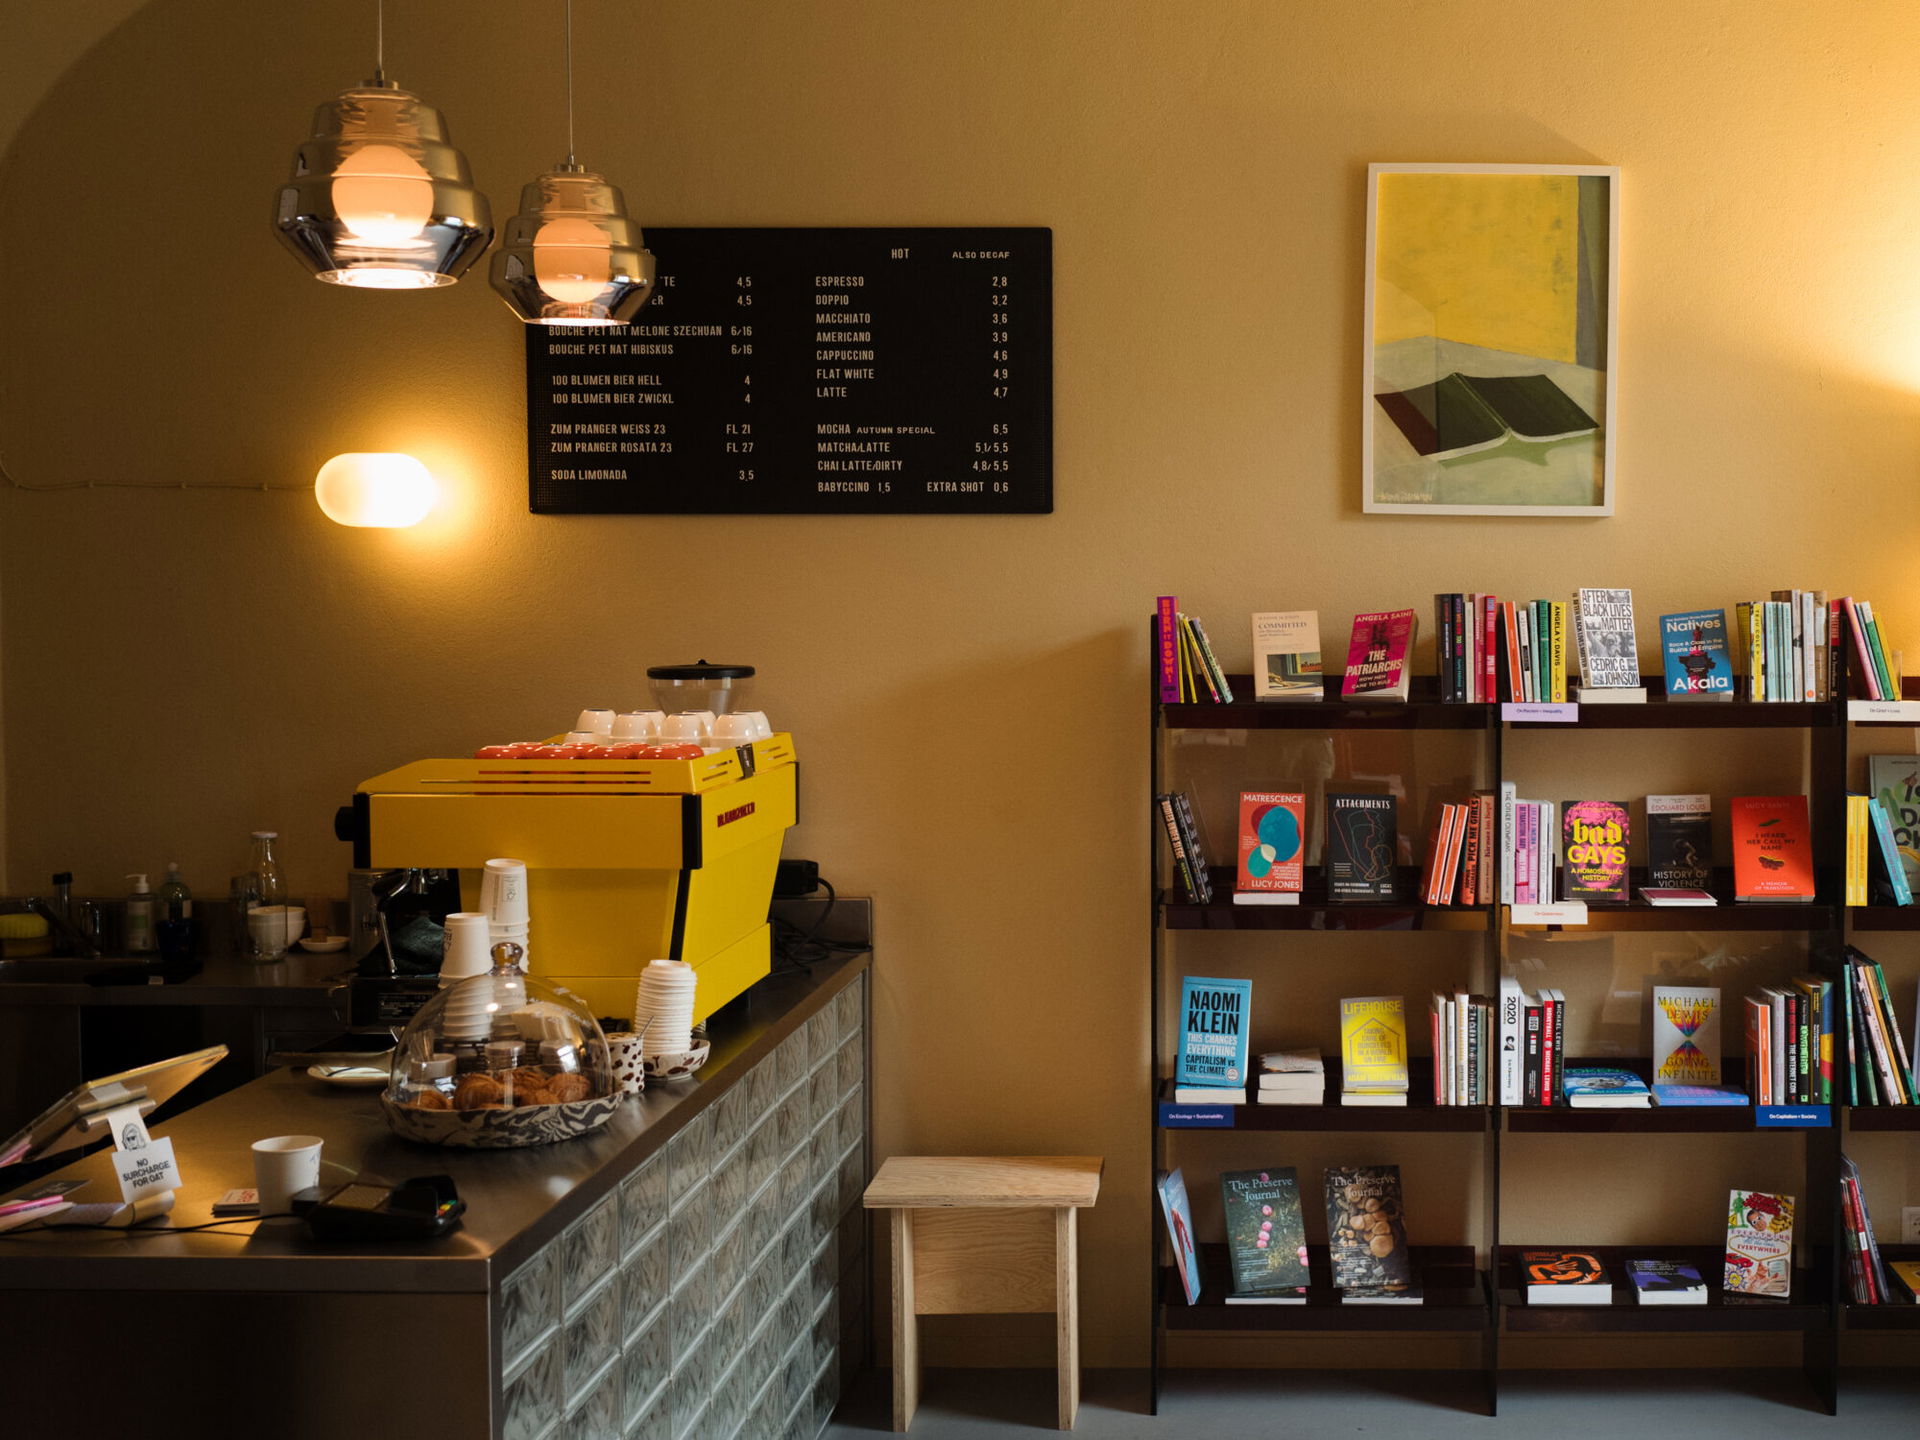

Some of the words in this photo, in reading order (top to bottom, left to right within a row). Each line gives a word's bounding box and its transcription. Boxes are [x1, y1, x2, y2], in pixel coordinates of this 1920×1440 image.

[891, 248, 909, 259] HOT
[952, 251, 977, 259] ALSO
[979, 251, 1010, 259] DECAF
[815, 276, 865, 287] ESPRESSO
[815, 295, 849, 306] DOPPIO
[815, 313, 871, 324] MACCHIATO
[548, 326, 585, 337] BOUCHE
[588, 326, 607, 337] PET
[609, 326, 627, 337] NAT
[630, 326, 670, 336] MELONE
[673, 325, 722, 336] SZECHUAN
[730, 325, 753, 337] 6/16
[816, 331, 871, 343] AMERICANO
[549, 344, 586, 355] BOUCHE
[588, 344, 607, 355] PET
[609, 344, 628, 355] NAT
[630, 344, 674, 355] HIBISKUS
[731, 344, 753, 355] 6/16
[816, 349, 874, 361] CAPPUCCINO
[816, 368, 841, 379] FLAT
[843, 368, 875, 379] WHITE
[552, 375, 568, 386] 100
[570, 375, 611, 386] BLUMEN
[613, 375, 635, 386] BIER
[637, 375, 662, 386] HELL
[744, 375, 751, 386] 4
[816, 386, 847, 398] LATTE
[552, 393, 568, 404] 100
[571, 393, 611, 404] BLUMEN
[613, 393, 635, 404] BIER
[637, 393, 674, 404] ZWICKL
[744, 393, 751, 404] 4
[550, 424, 572, 435] ZUM
[574, 424, 617, 435] PRANGER
[620, 424, 651, 435] WEISS
[653, 424, 666, 435] 23
[726, 424, 739, 435] FL
[817, 423, 851, 435] MOCHA
[856, 426, 893, 435] AUTUMN
[896, 426, 936, 435] SPECIAL
[550, 442, 572, 453] ZUM
[575, 442, 617, 453] PRANGER
[620, 442, 658, 453] ROSATA
[659, 442, 672, 453] 23
[726, 442, 739, 453] FL
[742, 442, 754, 453] 27
[817, 460, 839, 471] CHAI
[551, 470, 576, 481] SODA
[578, 470, 628, 481] LIMONADA
[817, 481, 870, 493] BABYCCINO
[926, 481, 958, 493] EXTRA
[960, 481, 985, 493] SHOT
[1582, 590, 1606, 604] AFTER
[1583, 604, 1609, 617] BLACK
[1609, 604, 1632, 617] LIVES
[1356, 614, 1389, 622] ANGELA
[1601, 617, 1633, 631] MATTER
[1666, 619, 1721, 633] Natives
[1369, 650, 1386, 662] THE
[1345, 659, 1403, 676] PATRIARCHS
[1590, 658, 1619, 671] CEDRIC
[1604, 671, 1639, 685] JOHNSON
[1673, 675, 1728, 691] Akala
[1243, 794, 1303, 803] MATRESCENCE
[1335, 798, 1391, 809] ATTACHMENTS
[1470, 800, 1479, 824] GIRLS
[1469, 826, 1478, 840] ME
[1573, 817, 1623, 845] bad
[1467, 841, 1477, 862] PICK
[1567, 845, 1626, 864] GAYS
[1653, 870, 1693, 880] HISTORY
[1695, 870, 1708, 879] OF
[1251, 879, 1272, 888] LUCY
[1273, 880, 1299, 889] JONES
[1658, 879, 1705, 888] VIOLENCE
[1189, 990, 1241, 1012] NAOMI
[1658, 996, 1718, 1008] MICHAEL
[1343, 1000, 1402, 1015] LIFEHOUSE
[1507, 996, 1516, 1024] 2020
[1666, 1009, 1709, 1021] LEWIS
[1187, 1010, 1240, 1035] KLEIN
[1187, 1032, 1203, 1043] THIS
[1204, 1033, 1238, 1045] CHANGES
[1186, 1043, 1236, 1057] EVERYTHING
[1185, 1054, 1226, 1065] CAPITALISM
[1666, 1056, 1710, 1067] GOING
[1185, 1064, 1197, 1073] THE
[1198, 1065, 1225, 1075] CLIMATE
[1789, 1054, 1797, 1082] INTERNET
[1658, 1069, 1719, 1081] INFINITE
[1789, 1082, 1797, 1093] CON
[136, 1158, 148, 1168] NO
[122, 1160, 171, 1182] SURCHARGE
[132, 1178, 149, 1188] FOR
[148, 1171, 164, 1183] OAT
[1228, 1180, 1249, 1191] The
[1252, 1178, 1293, 1189] Preserve
[1331, 1176, 1352, 1187] The
[1354, 1175, 1396, 1185] Preserve
[1244, 1189, 1281, 1203] Journal
